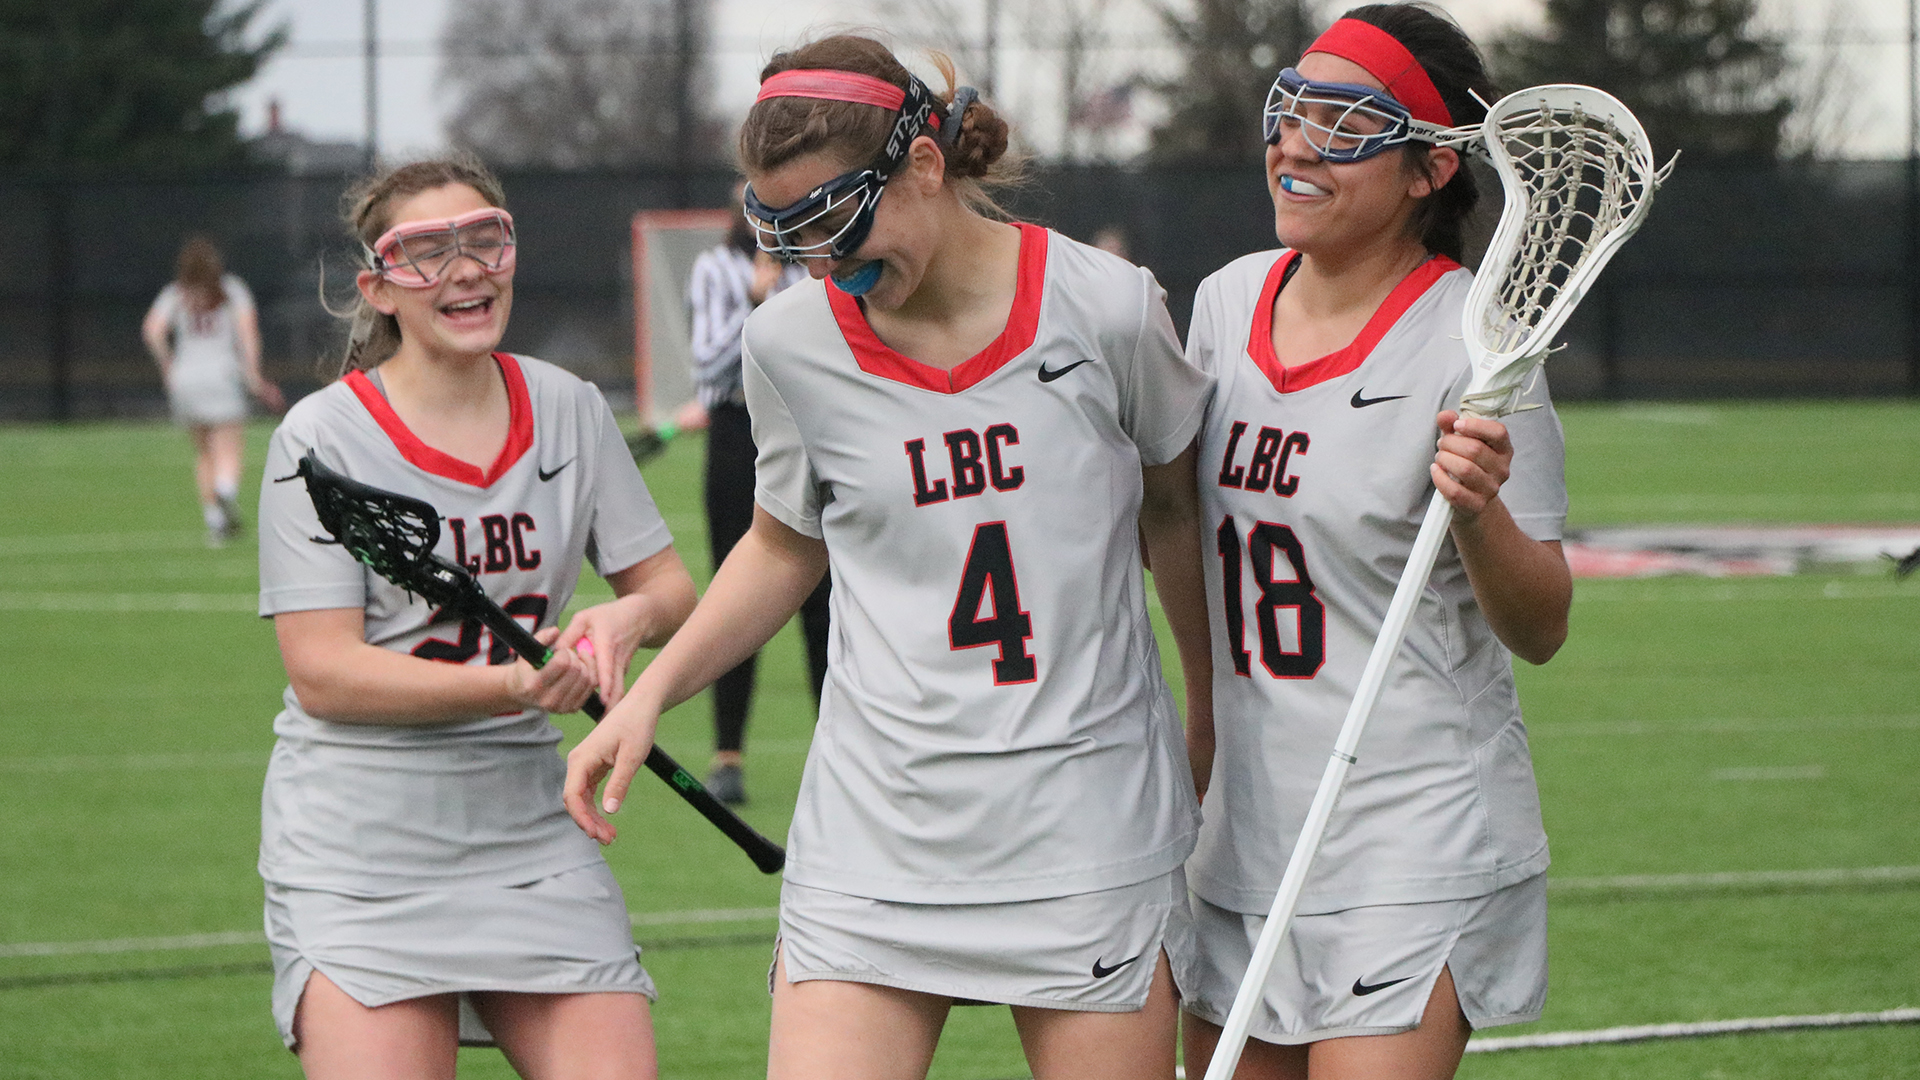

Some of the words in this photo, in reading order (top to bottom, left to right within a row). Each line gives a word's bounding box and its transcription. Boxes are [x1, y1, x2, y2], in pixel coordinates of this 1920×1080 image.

[885, 107, 913, 161] STX
[908, 95, 932, 140] STX
[904, 422, 1025, 507] LBC
[1218, 420, 1311, 498] LBC
[448, 512, 541, 574] LBC
[947, 520, 1037, 686] 4
[1217, 513, 1326, 680] 18
